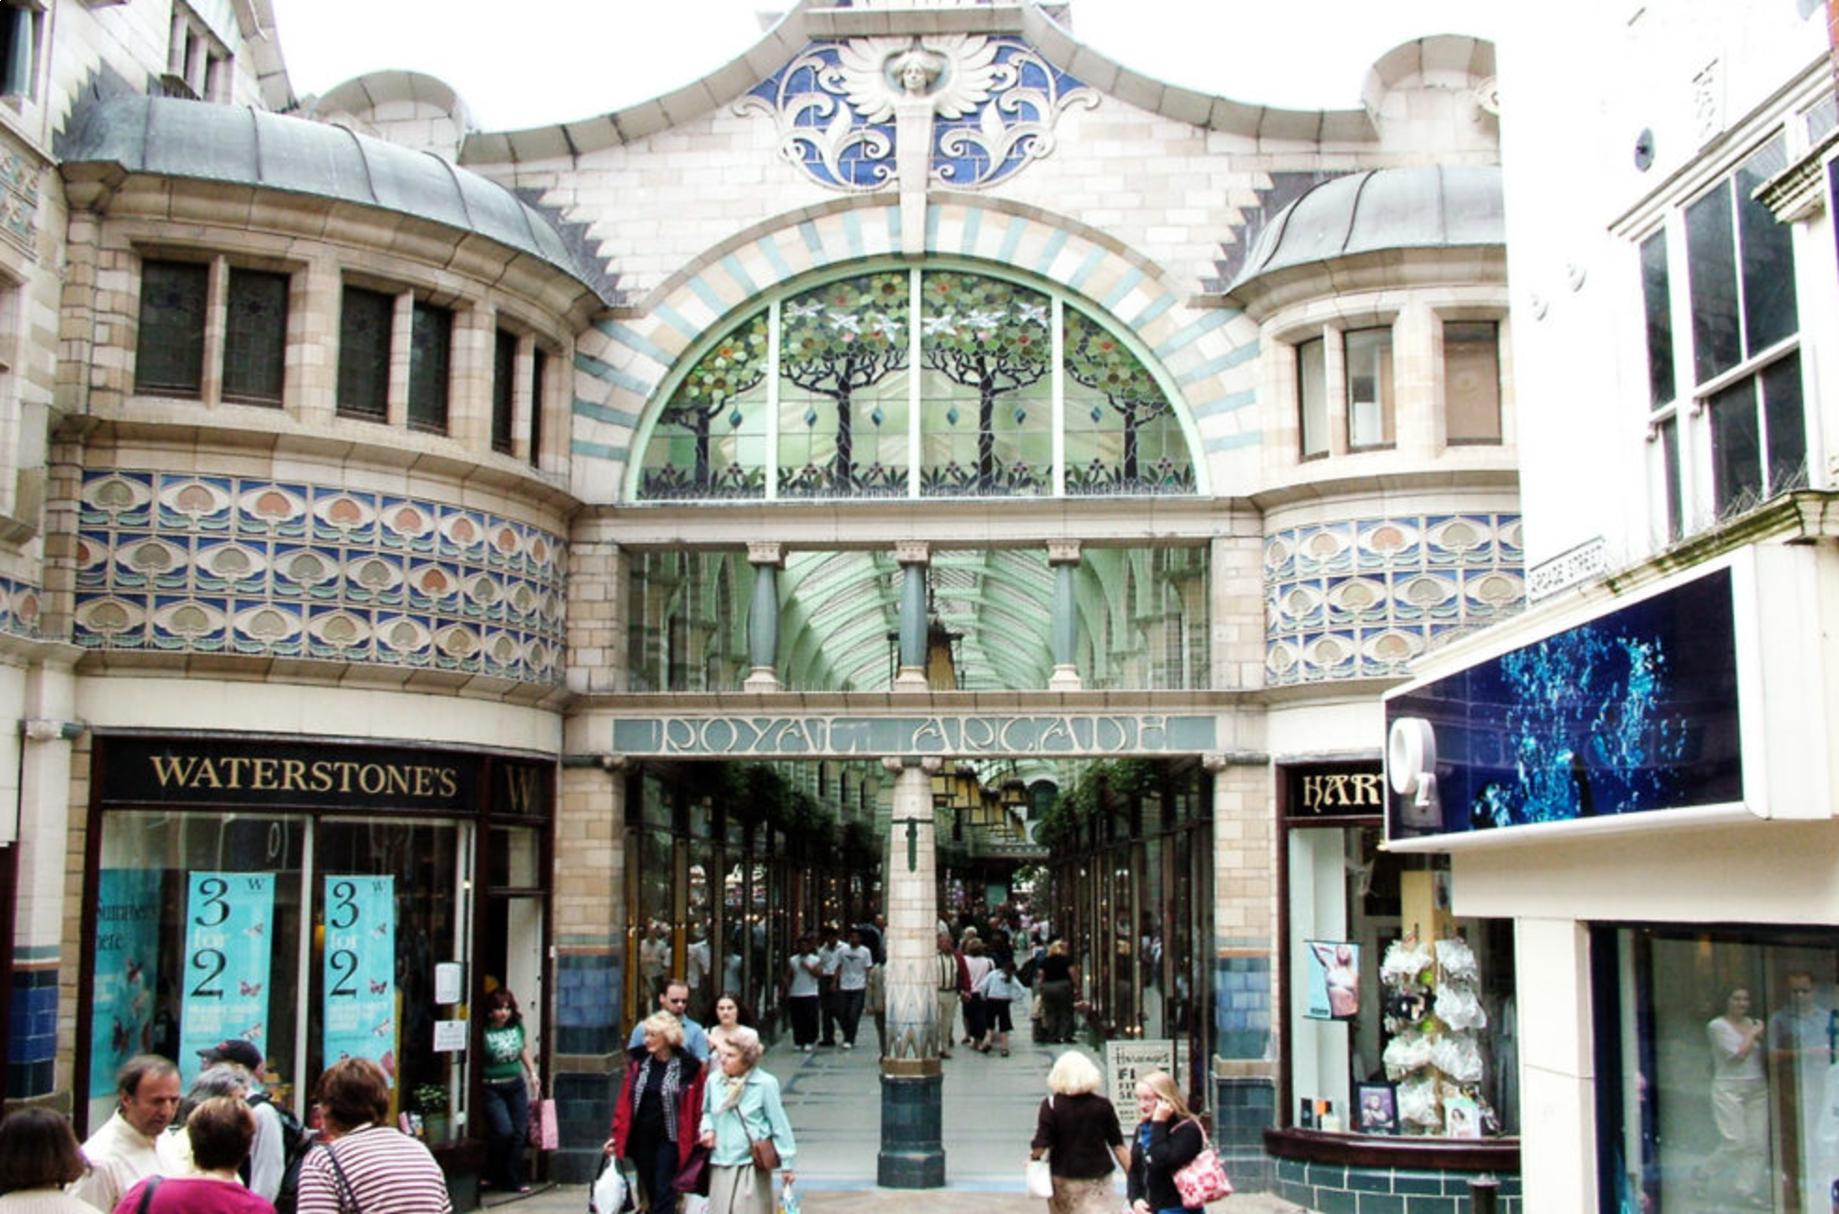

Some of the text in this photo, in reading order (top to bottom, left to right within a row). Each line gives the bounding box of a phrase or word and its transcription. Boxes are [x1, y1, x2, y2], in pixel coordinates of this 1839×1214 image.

[660, 714, 1169, 754] ROYAL ARCADE
[149, 755, 458, 798] WATERSTONE'S
[504, 764, 539, 812] W
[1303, 773, 1384, 813] HAR
[195, 877, 230, 927] 3
[248, 878, 264, 891] W
[331, 881, 359, 929] 3
[190, 948, 226, 1000] 2
[330, 949, 358, 999] 2
